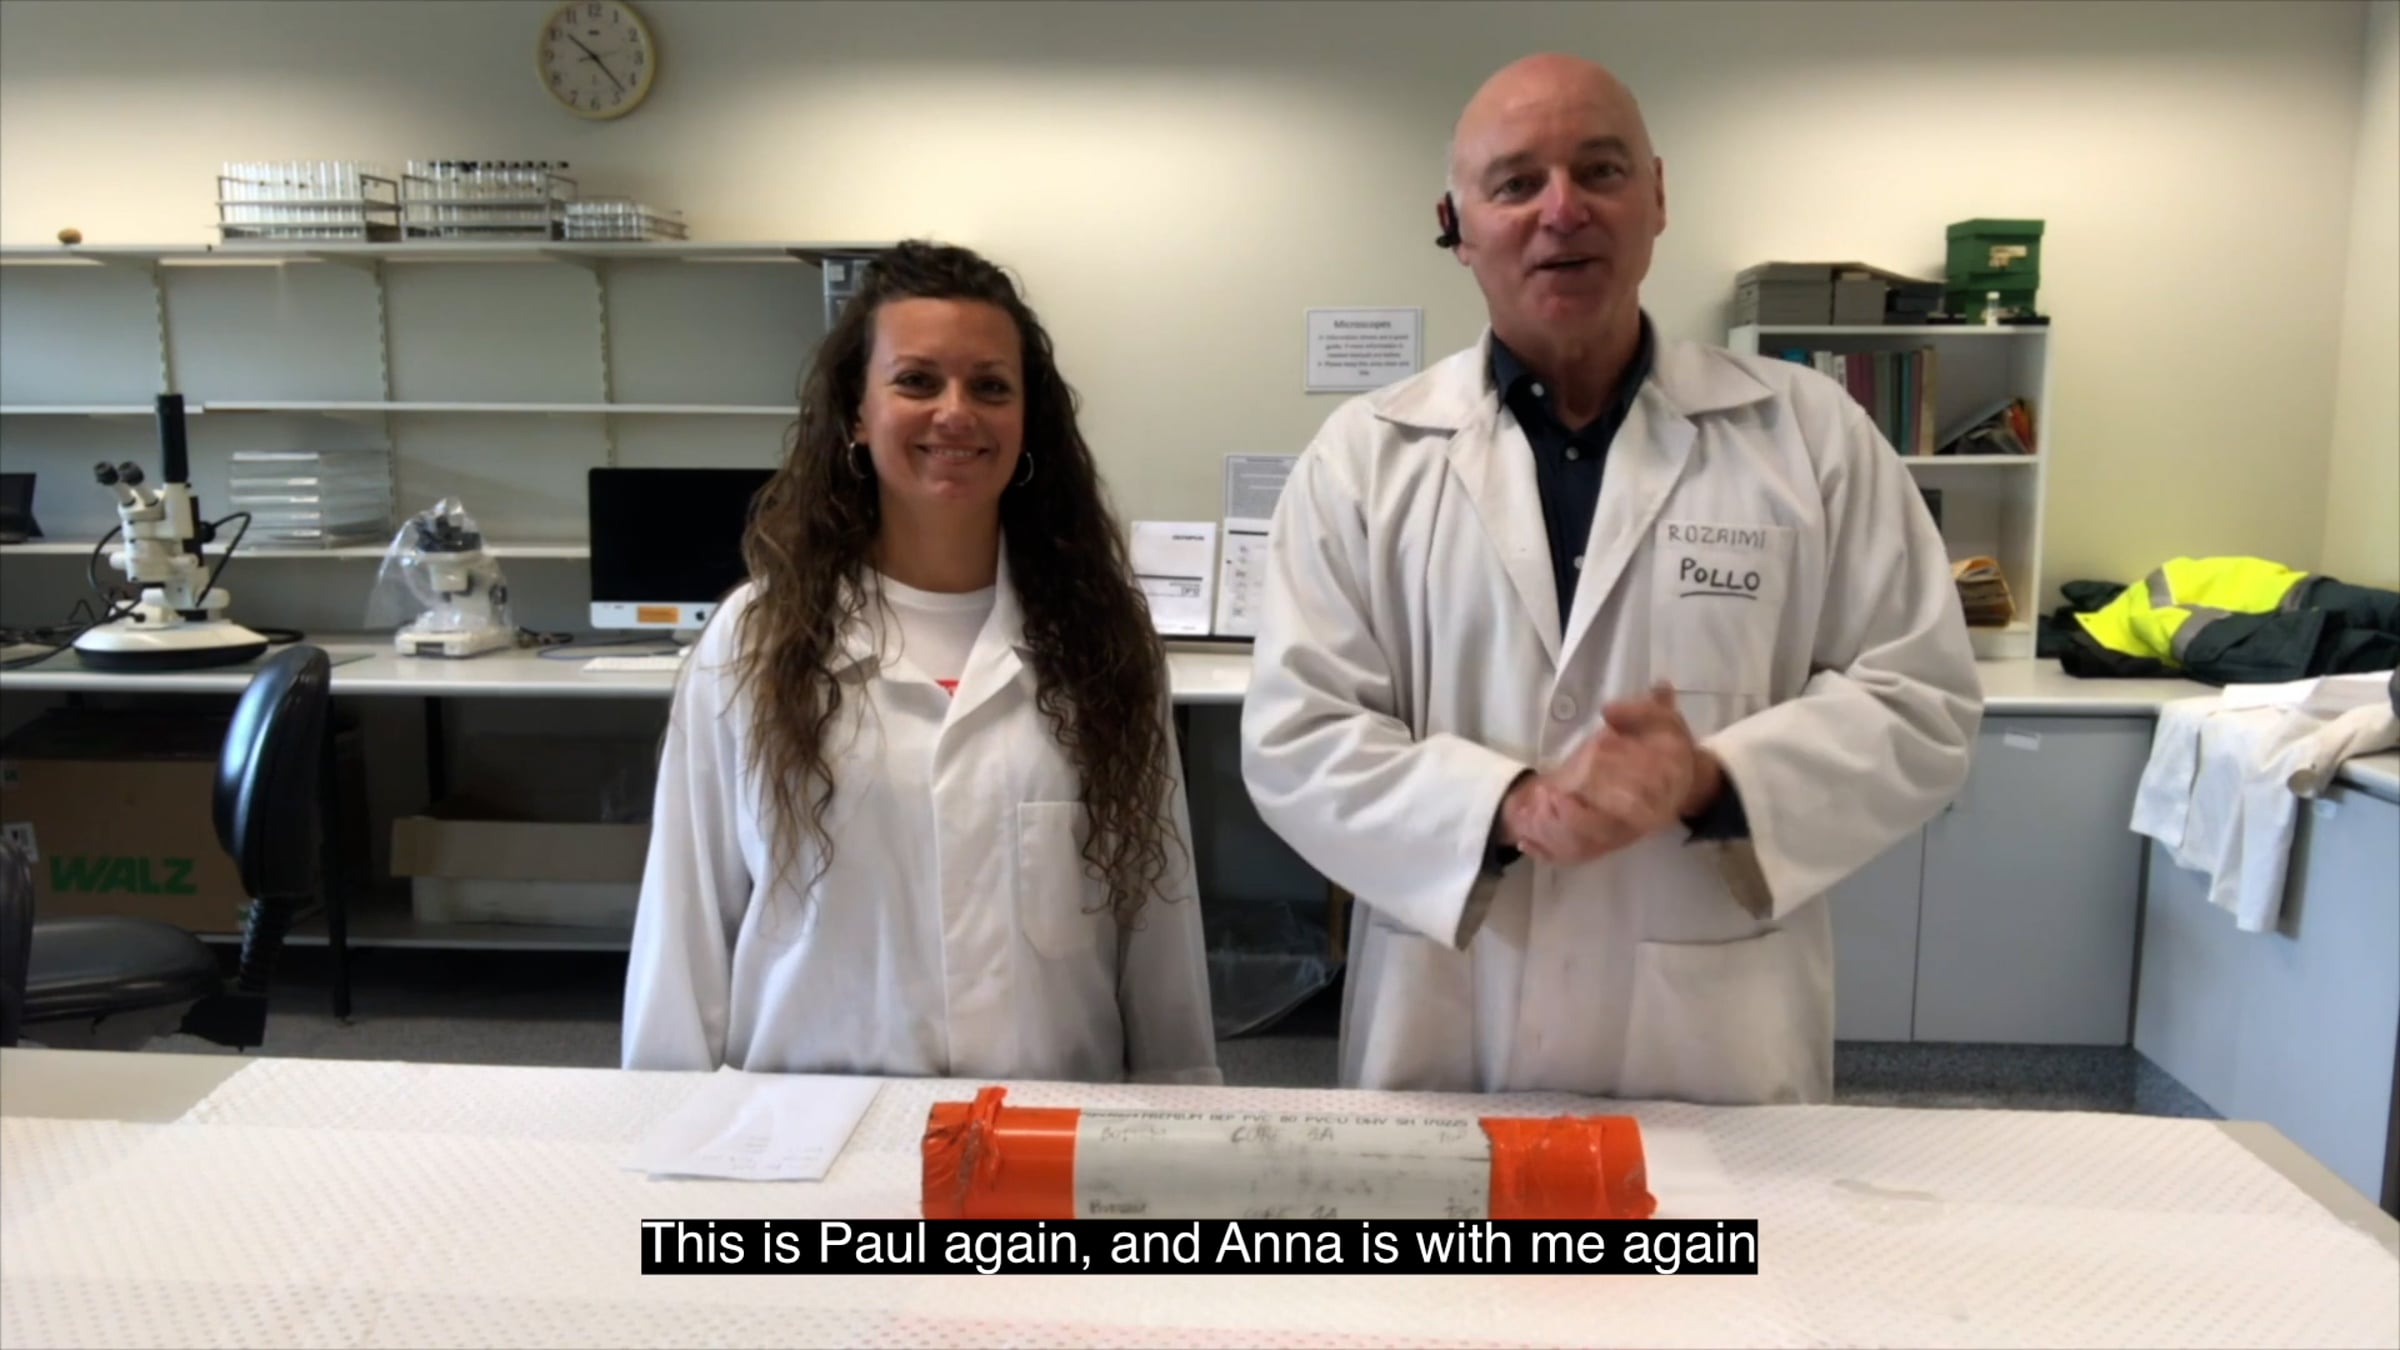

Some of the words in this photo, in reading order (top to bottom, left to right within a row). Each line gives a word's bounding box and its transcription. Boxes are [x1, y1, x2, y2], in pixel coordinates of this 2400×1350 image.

[566, 8, 577, 24] 11
[588, 3, 601, 17] 12
[549, 27, 562, 41] 10
[628, 27, 638, 42] 2
[544, 49, 555, 64] 9
[634, 50, 644, 64] 3
[570, 89, 579, 105] 7
[590, 96, 601, 111] 6
[1334, 320, 1391, 329] Microscopes
[1668, 524, 1766, 549] ROZAIMI
[1680, 557, 1761, 591] POLLO
[50, 855, 198, 895] WALZ
